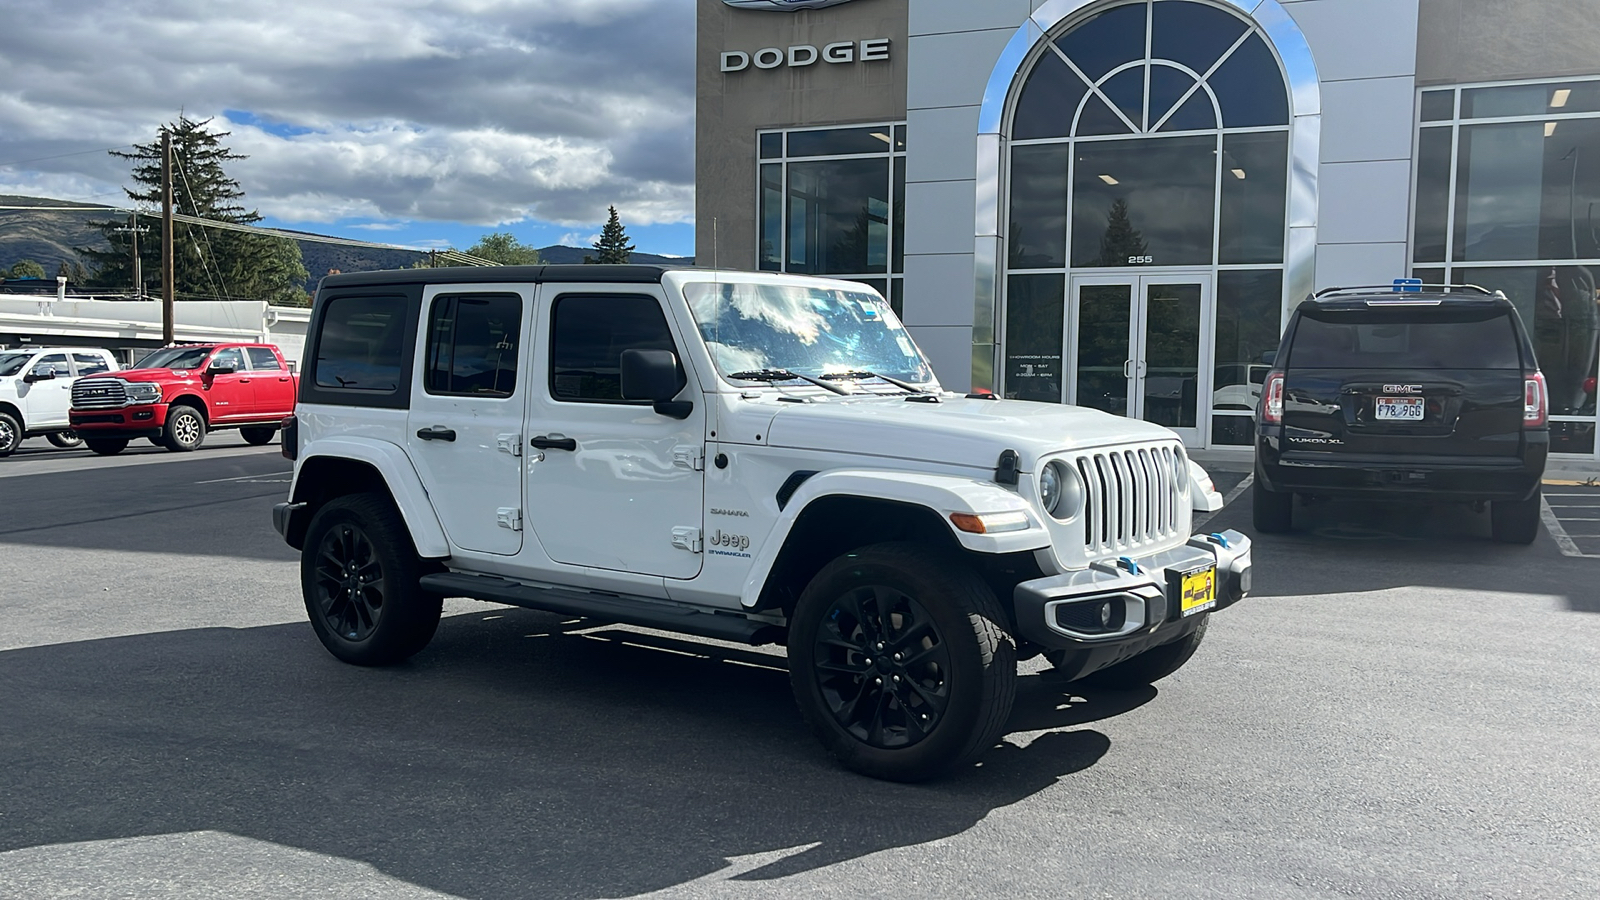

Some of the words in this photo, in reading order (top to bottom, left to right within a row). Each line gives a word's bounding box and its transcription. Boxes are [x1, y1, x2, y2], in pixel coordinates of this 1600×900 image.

[720, 38, 891, 73] DODGE
[1128, 255, 1153, 264] 255
[1382, 384, 1423, 394] GMC
[710, 508, 749, 518] SAHARA
[710, 529, 750, 551] Jeep
[714, 549, 751, 558] WRANGLER
